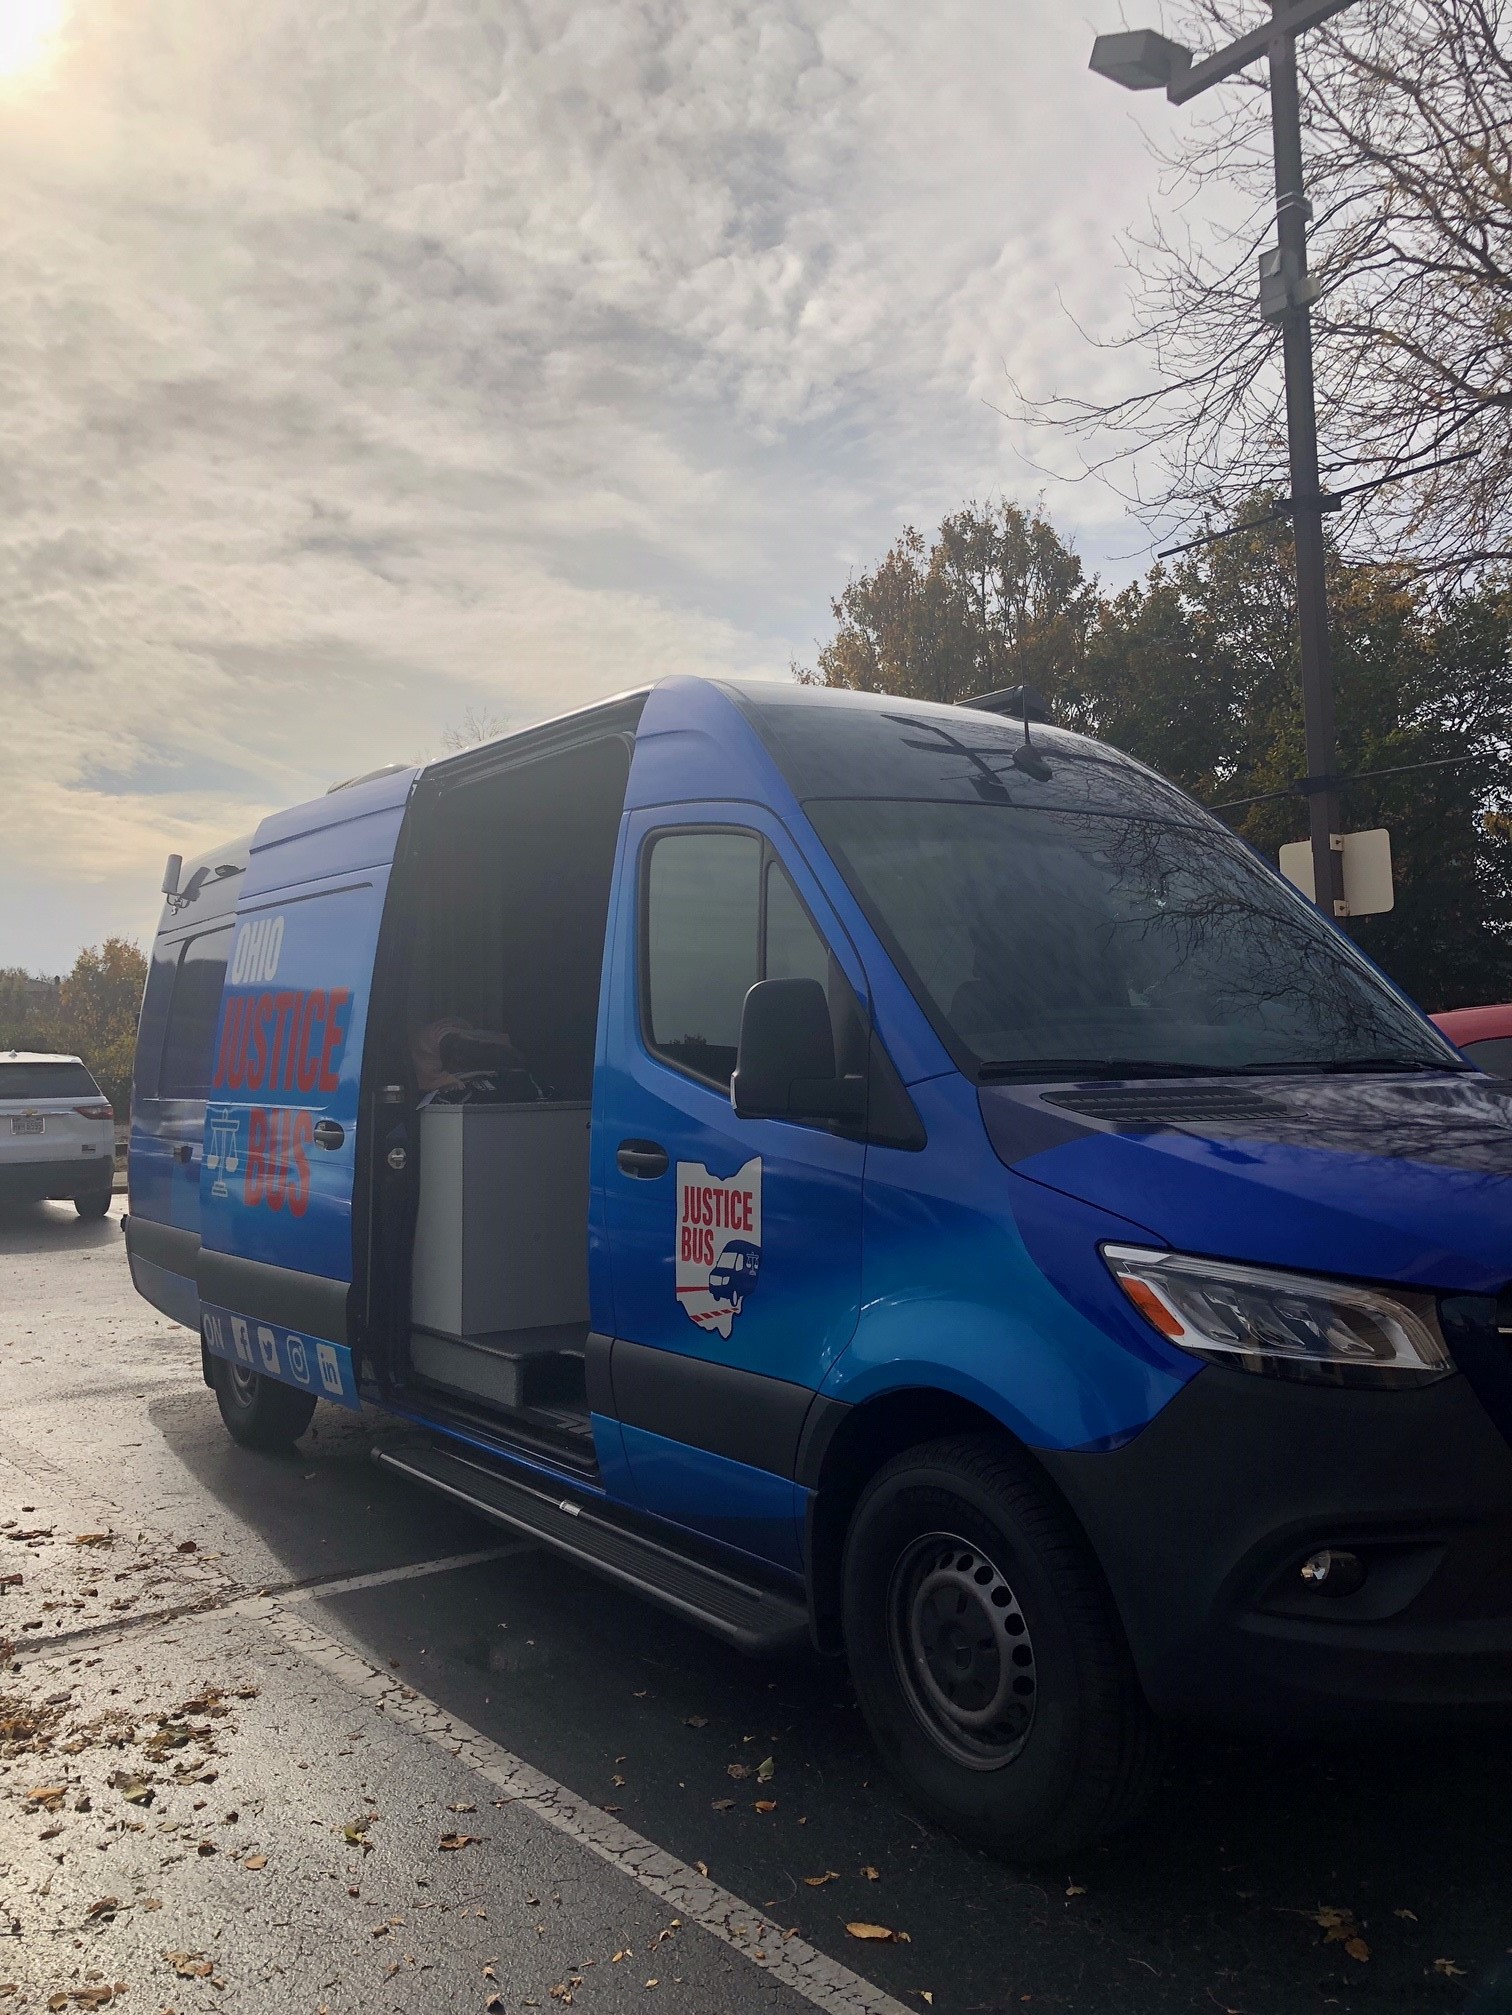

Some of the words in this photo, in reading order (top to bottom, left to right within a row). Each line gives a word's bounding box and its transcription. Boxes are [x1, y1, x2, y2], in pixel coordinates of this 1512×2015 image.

[231, 915, 285, 985] OHIO
[213, 985, 350, 1094] JUSTICE
[243, 1106, 313, 1218] BUS
[682, 1185, 753, 1232] JUSTICE
[681, 1226, 714, 1266] BUS
[203, 1313, 225, 1350] ON
